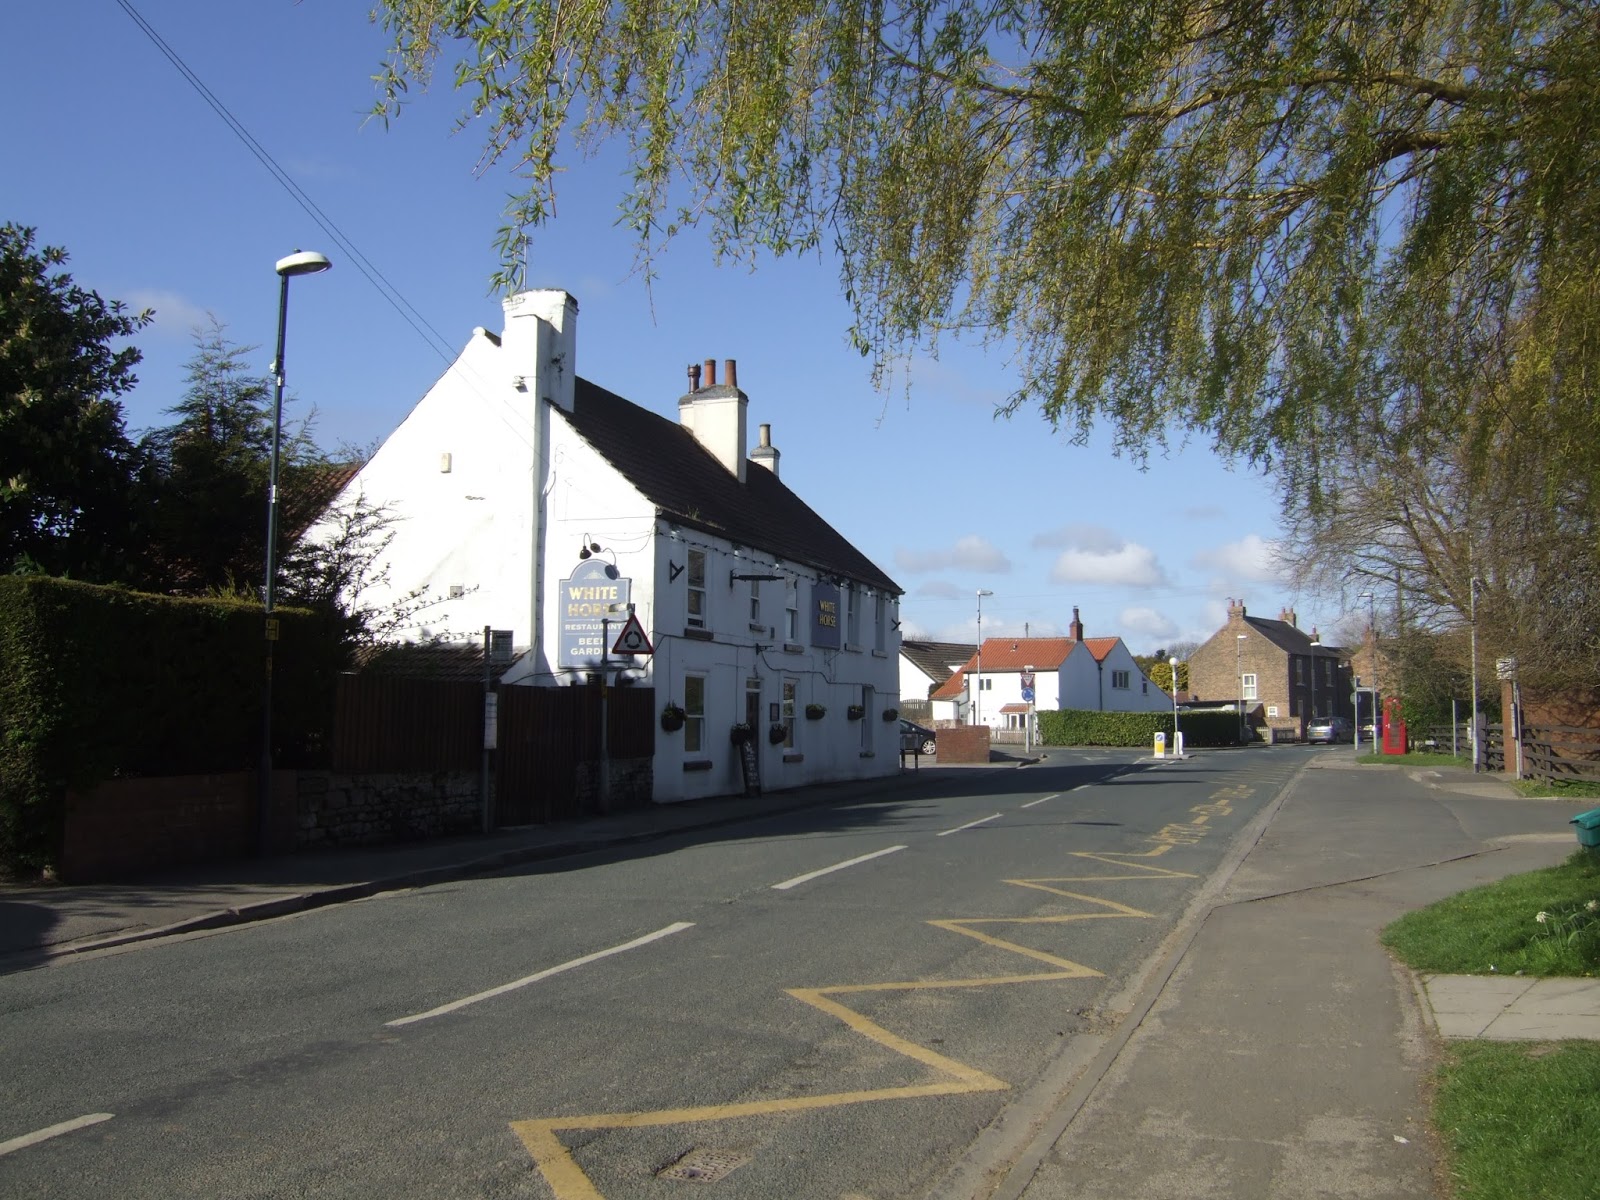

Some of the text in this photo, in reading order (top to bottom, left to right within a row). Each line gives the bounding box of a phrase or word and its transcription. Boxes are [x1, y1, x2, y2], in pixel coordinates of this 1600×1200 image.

[569, 587, 617, 600] WHITE
[568, 603, 619, 616] HORS
[819, 600, 835, 613] WHITE
[819, 614, 836, 627] HORSE
